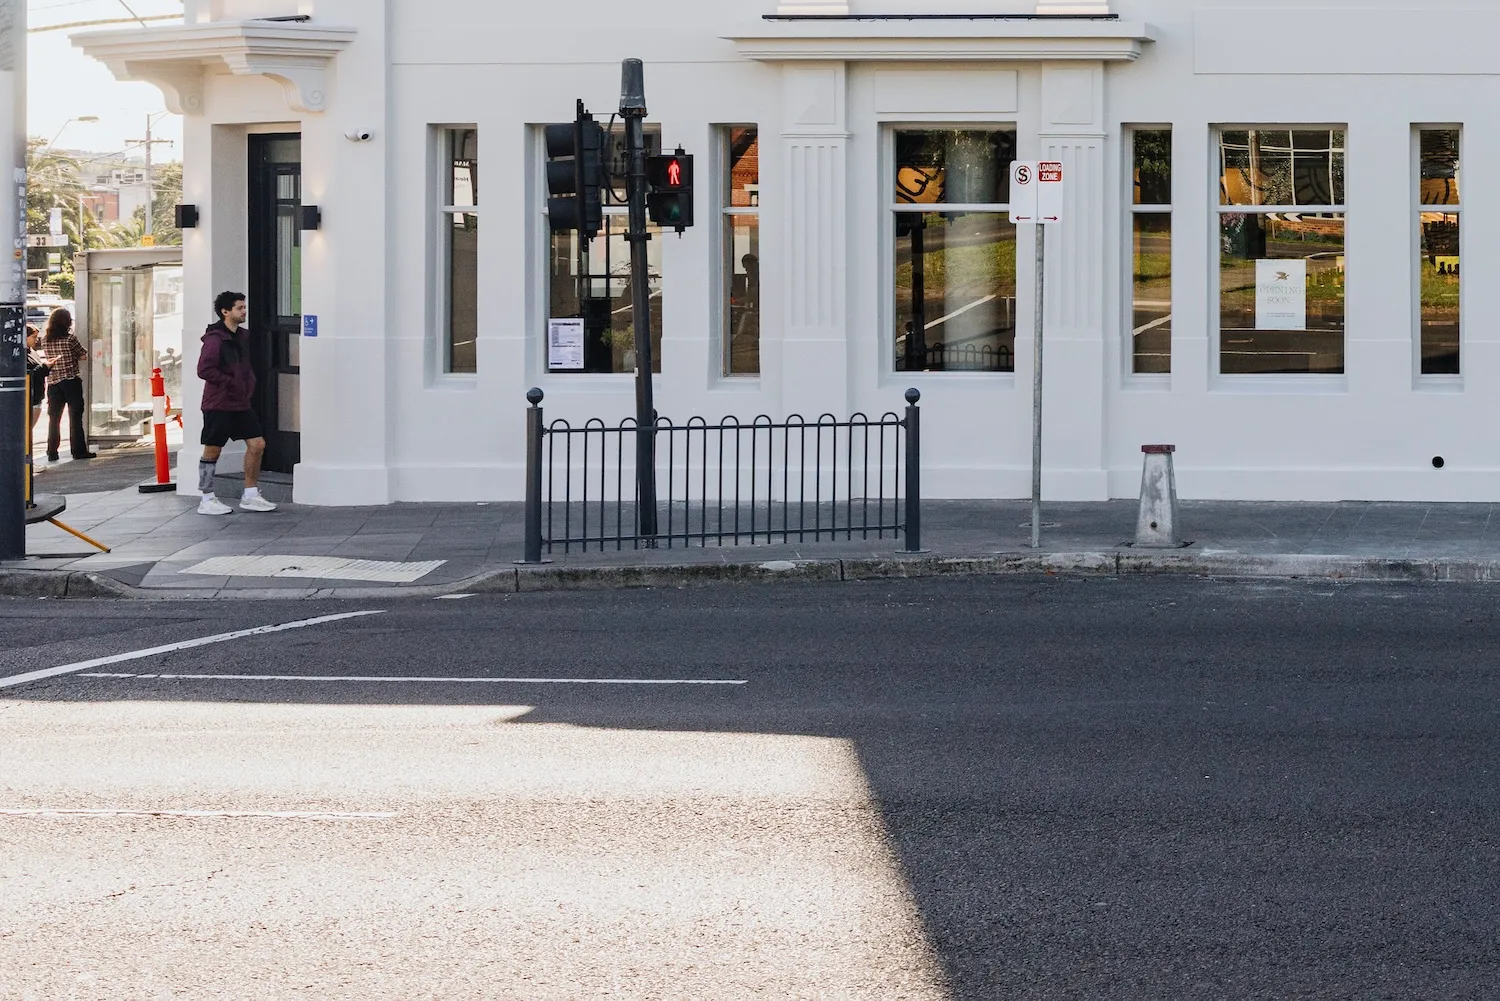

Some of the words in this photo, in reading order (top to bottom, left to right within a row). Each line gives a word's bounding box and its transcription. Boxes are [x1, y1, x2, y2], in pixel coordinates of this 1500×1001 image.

[1039, 163, 1062, 172] LOADING
[1041, 172, 1058, 181] ZONE
[35, 236, 46, 246] 33
[1259, 286, 1302, 295] OPENING
